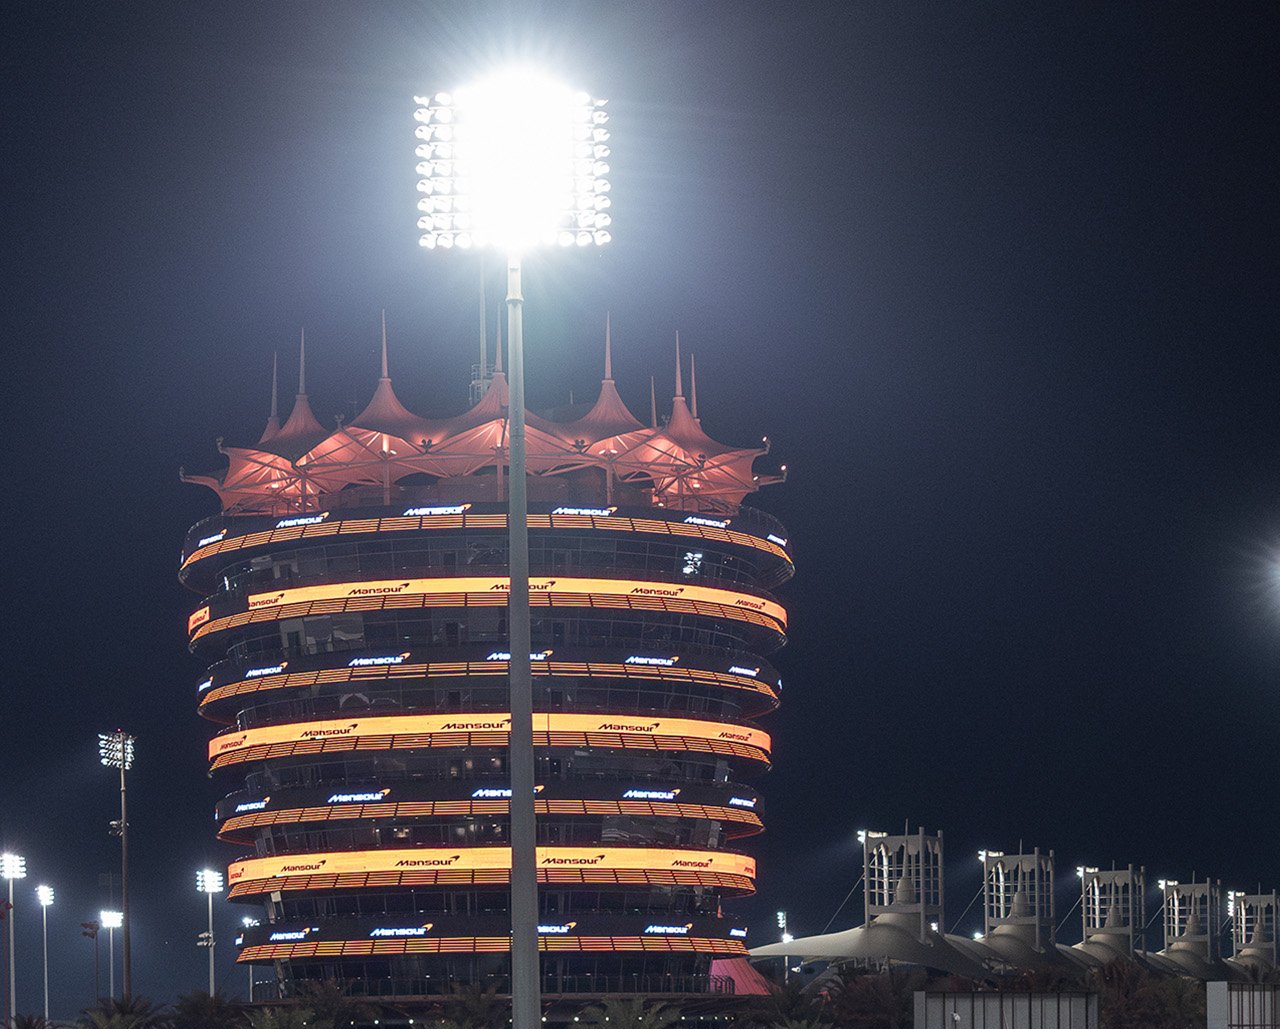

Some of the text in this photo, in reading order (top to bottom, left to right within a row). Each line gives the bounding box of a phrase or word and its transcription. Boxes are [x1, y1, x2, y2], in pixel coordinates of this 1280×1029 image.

[348, 587, 402, 595] Mansour
[630, 588, 679, 596] Mansour
[249, 598, 275, 607] ansour
[598, 724, 654, 732] Mansour
[300, 729, 351, 738] Mansour
[281, 864, 320, 872] Mansour
